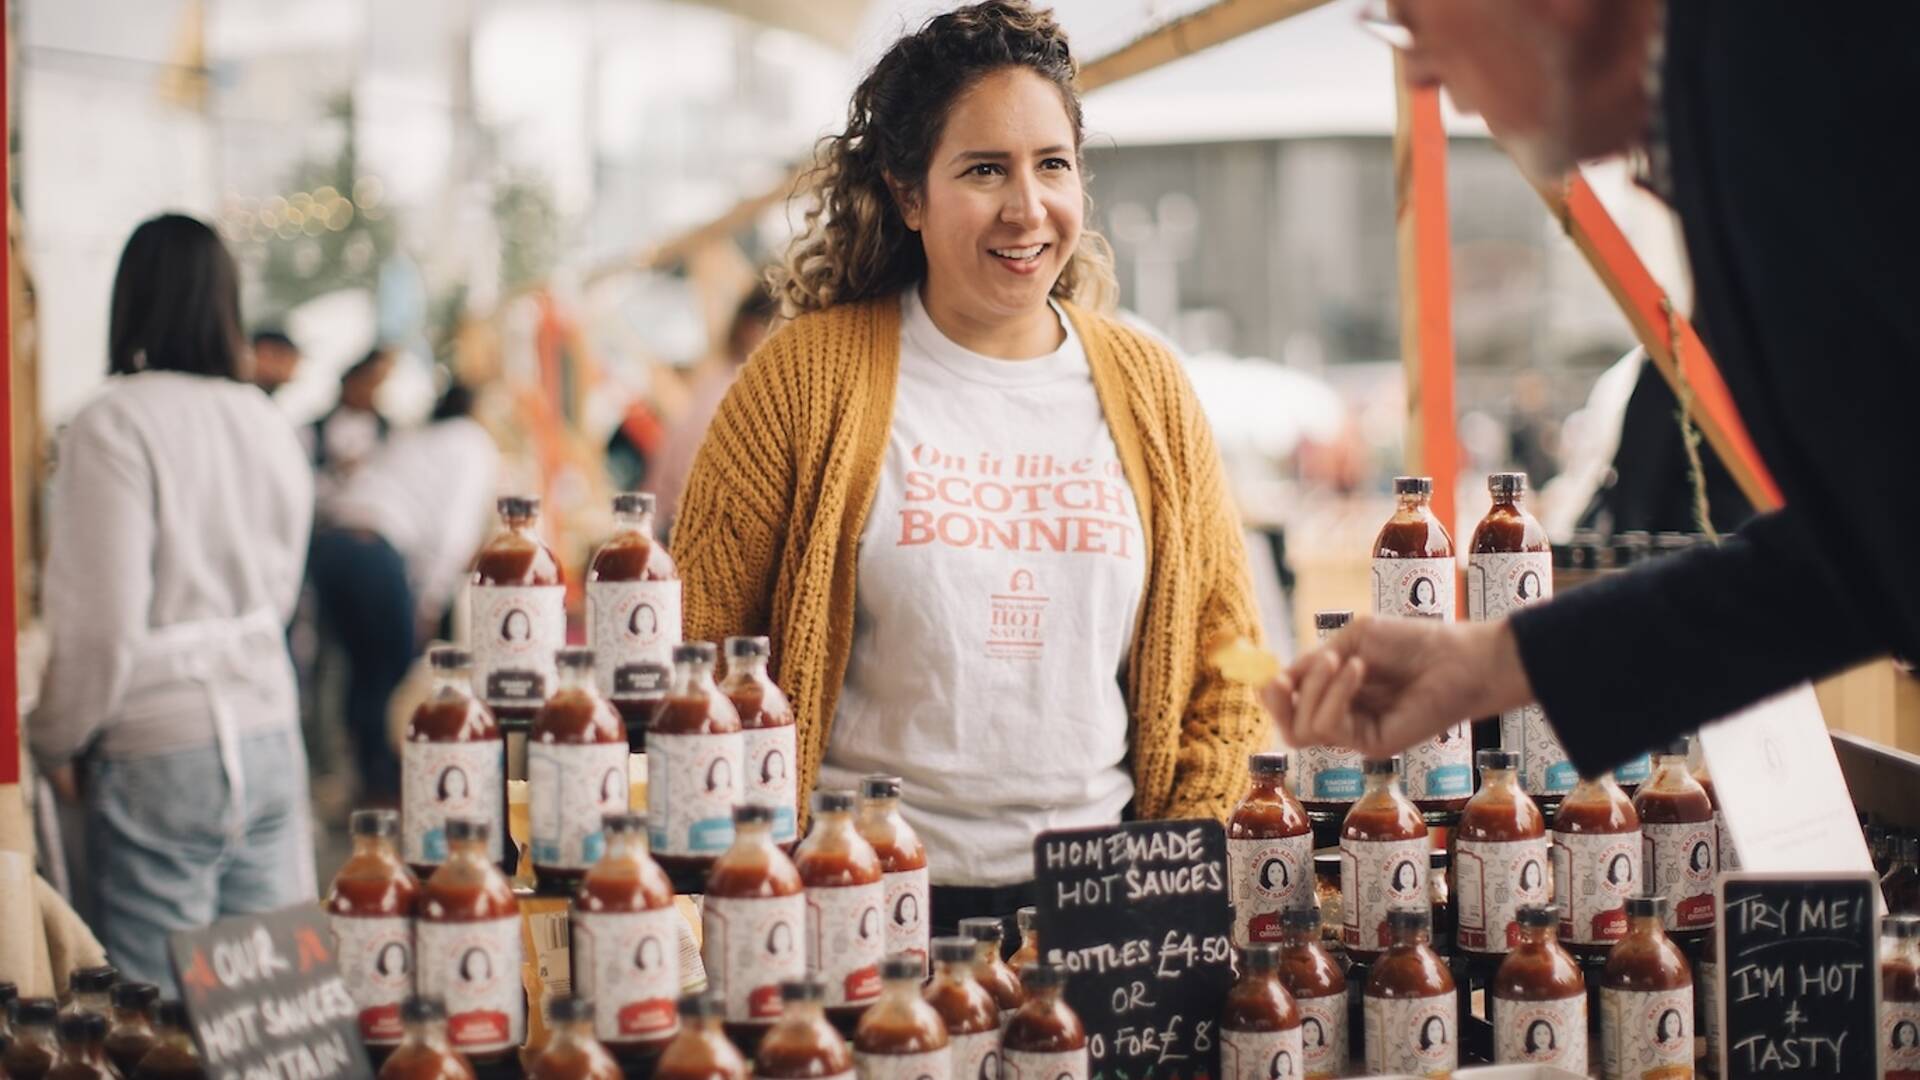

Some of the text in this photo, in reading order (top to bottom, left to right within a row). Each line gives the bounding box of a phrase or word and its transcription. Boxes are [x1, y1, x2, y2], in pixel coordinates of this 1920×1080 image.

[911, 442, 967, 472] On
[978, 452, 1001, 477] it
[1014, 454, 1094, 478] like
[904, 471, 1130, 518] SCOTCH
[896, 509, 1136, 560] BONNET
[1046, 828, 1204, 869] HOMEMADE
[1058, 861, 1223, 908] HOT SAUCES
[1725, 894, 1864, 935] TRY ME!
[213, 924, 290, 990] OUR
[1048, 930, 1229, 978] BOTTLES £4.50
[1112, 980, 1156, 1014] OR
[1732, 963, 1864, 1002] I'M HOT
[199, 1006, 260, 1065] HOT
[1114, 1027, 1160, 1056] FOR
[1194, 1019, 1213, 1051] 8
[1733, 1031, 1848, 1074] TASTY
